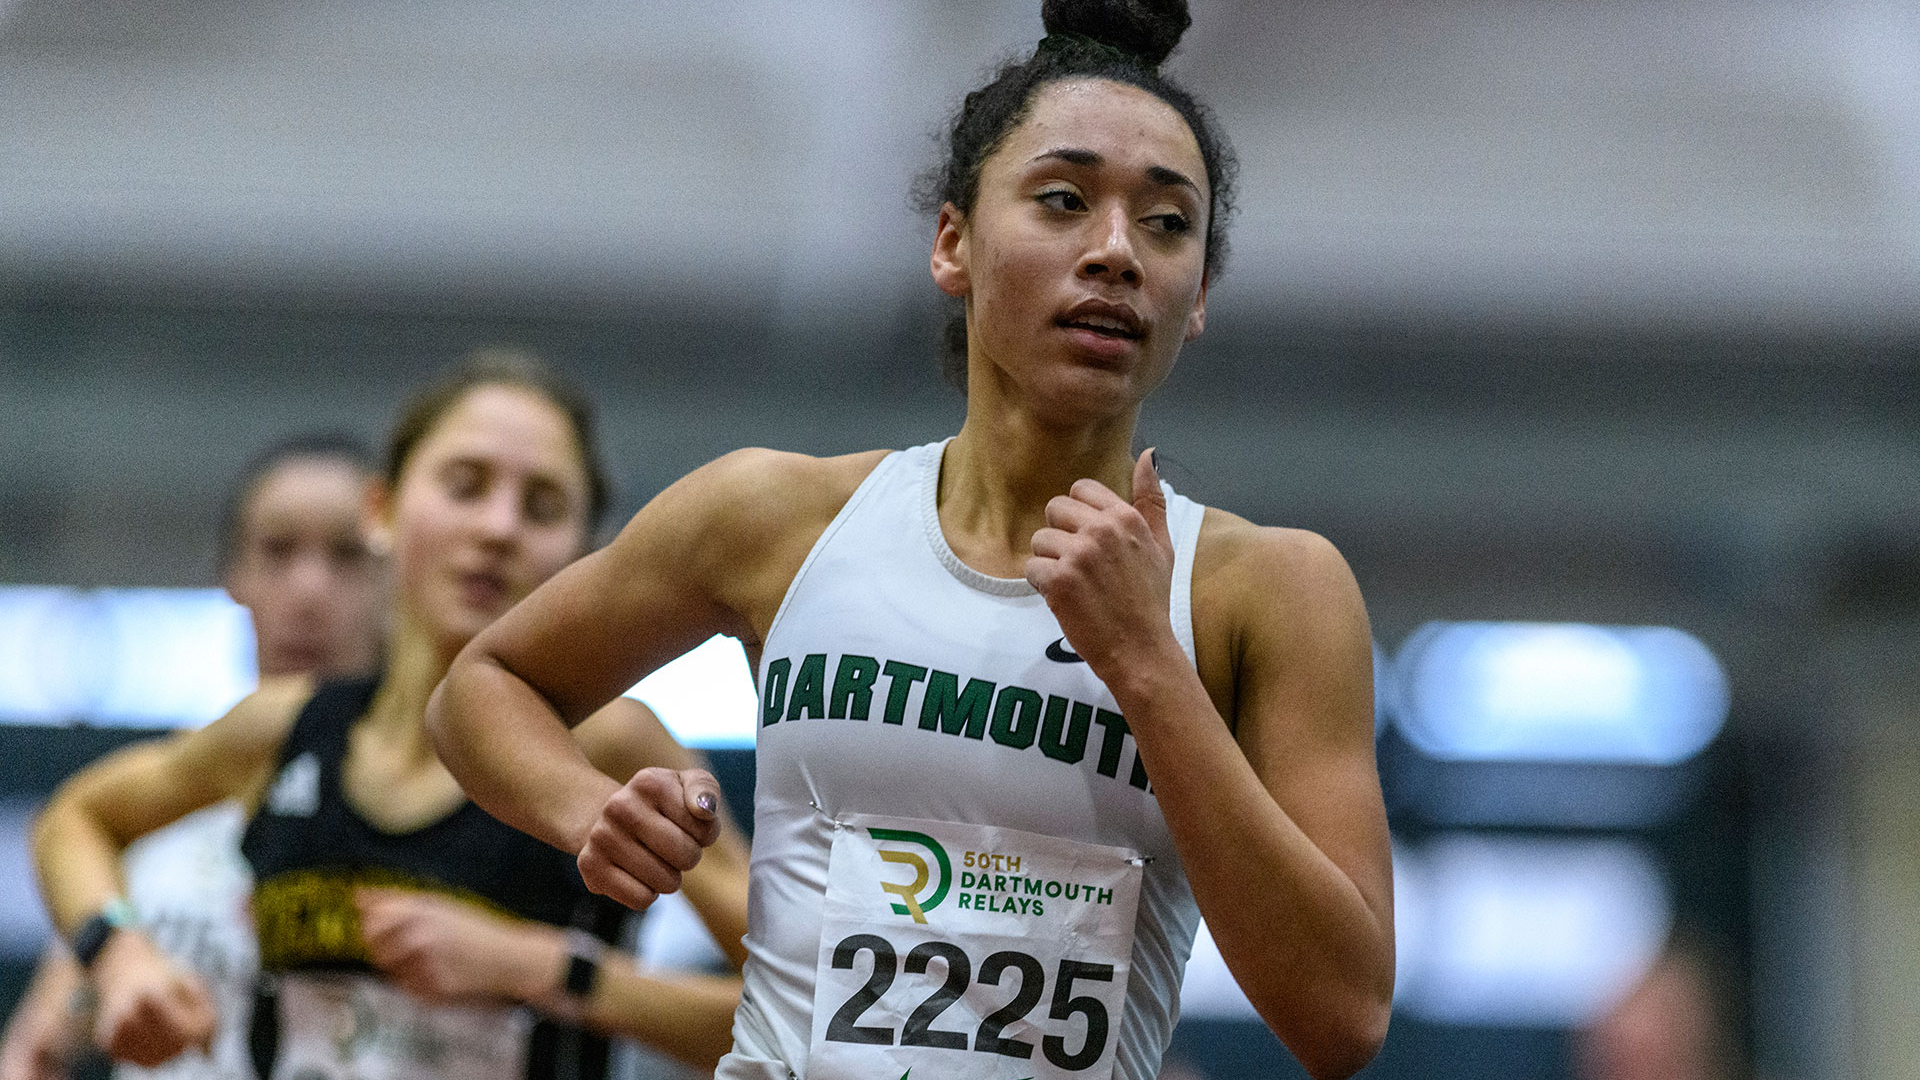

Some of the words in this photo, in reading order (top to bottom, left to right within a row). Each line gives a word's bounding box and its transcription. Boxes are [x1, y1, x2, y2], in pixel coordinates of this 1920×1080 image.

[762, 653, 1155, 794] DARTMOUT
[963, 851, 1021, 873] 50TH
[958, 893, 1044, 916] RELAYS
[960, 872, 1114, 906] DARTMOUTH
[825, 933, 1115, 1072] 2225
